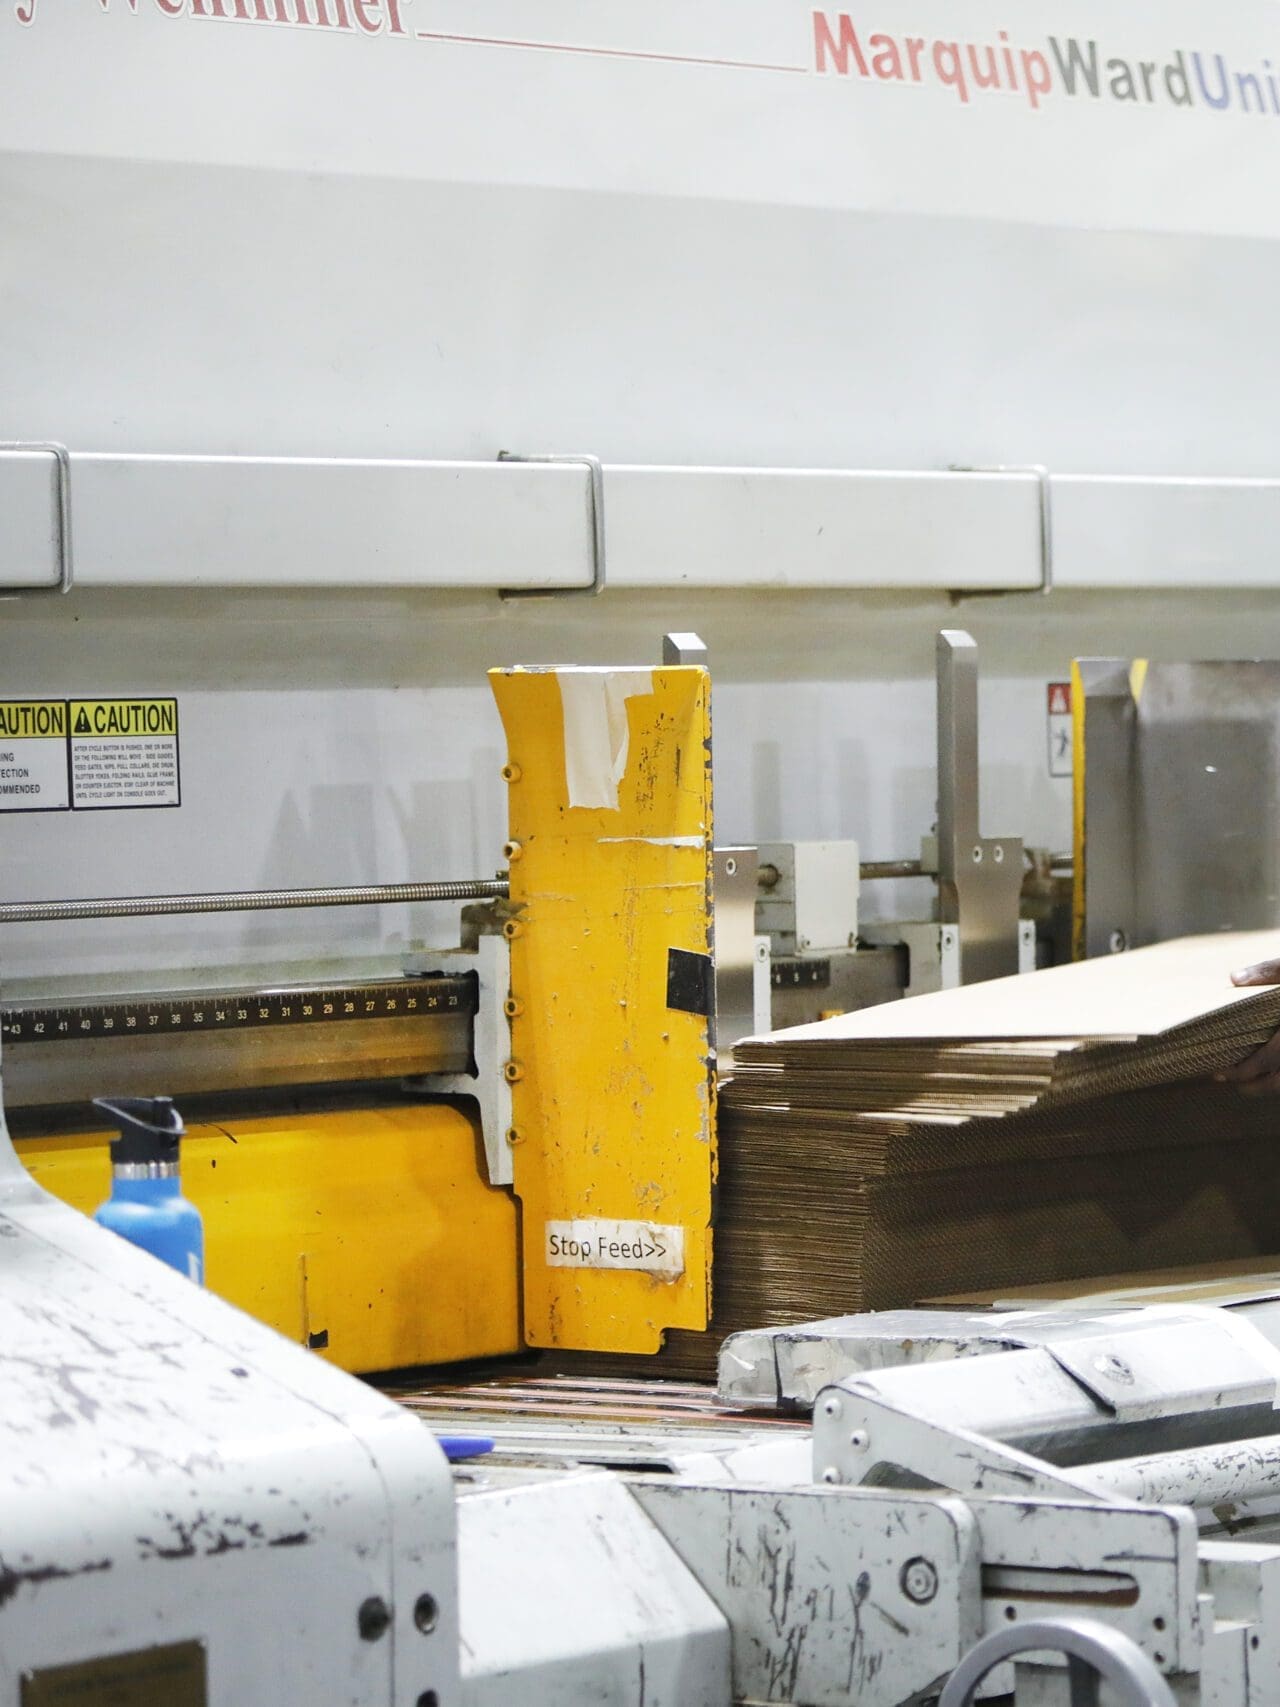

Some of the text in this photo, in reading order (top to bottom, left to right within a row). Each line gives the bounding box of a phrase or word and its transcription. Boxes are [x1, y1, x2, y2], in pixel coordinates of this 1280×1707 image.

[94, 704, 173, 733] CAUTION
[0, 768, 29, 778] ECTION
[10, 997, 457, 1034] 43 42 41 40 39 38 37 36 35 34 33 32 31 30 29 28 27 26 25 24 23
[550, 1234, 591, 1261] Stop
